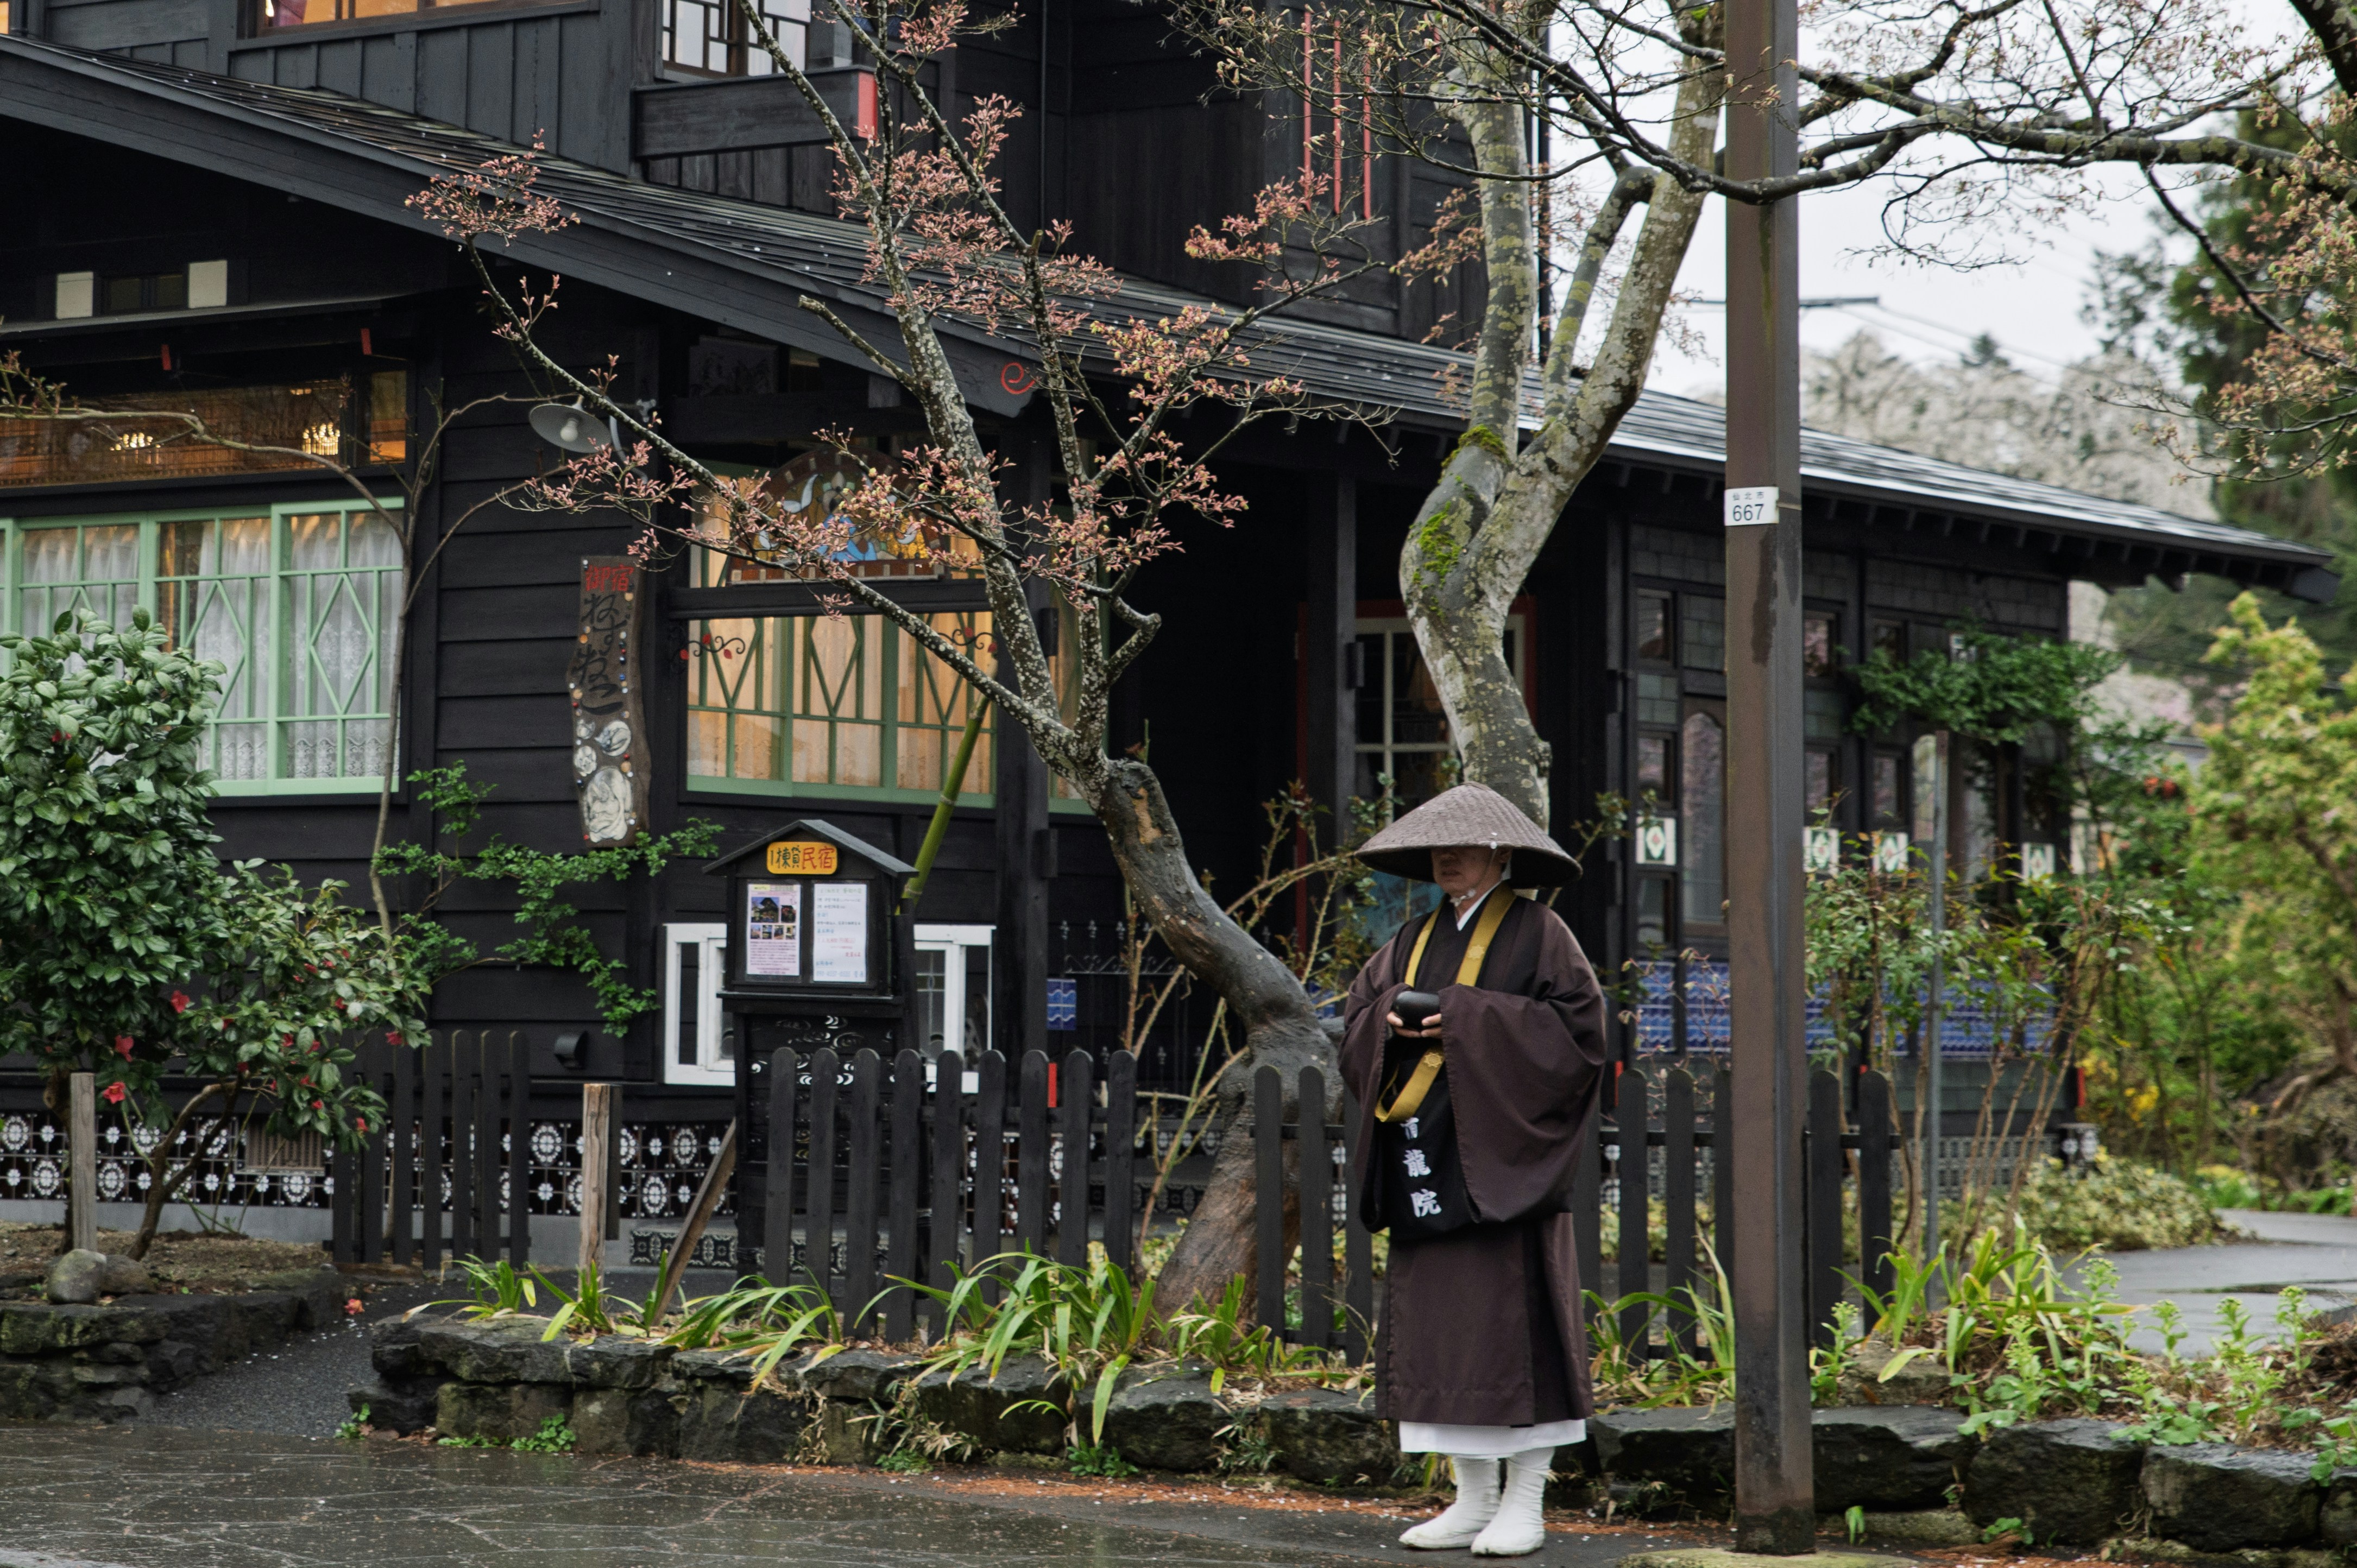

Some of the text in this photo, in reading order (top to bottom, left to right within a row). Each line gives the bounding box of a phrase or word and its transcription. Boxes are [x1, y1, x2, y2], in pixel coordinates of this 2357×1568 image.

[1732, 491, 1764, 501] 仙北市
[1733, 504, 1764, 521] 667
[585, 564, 634, 591] 御宿
